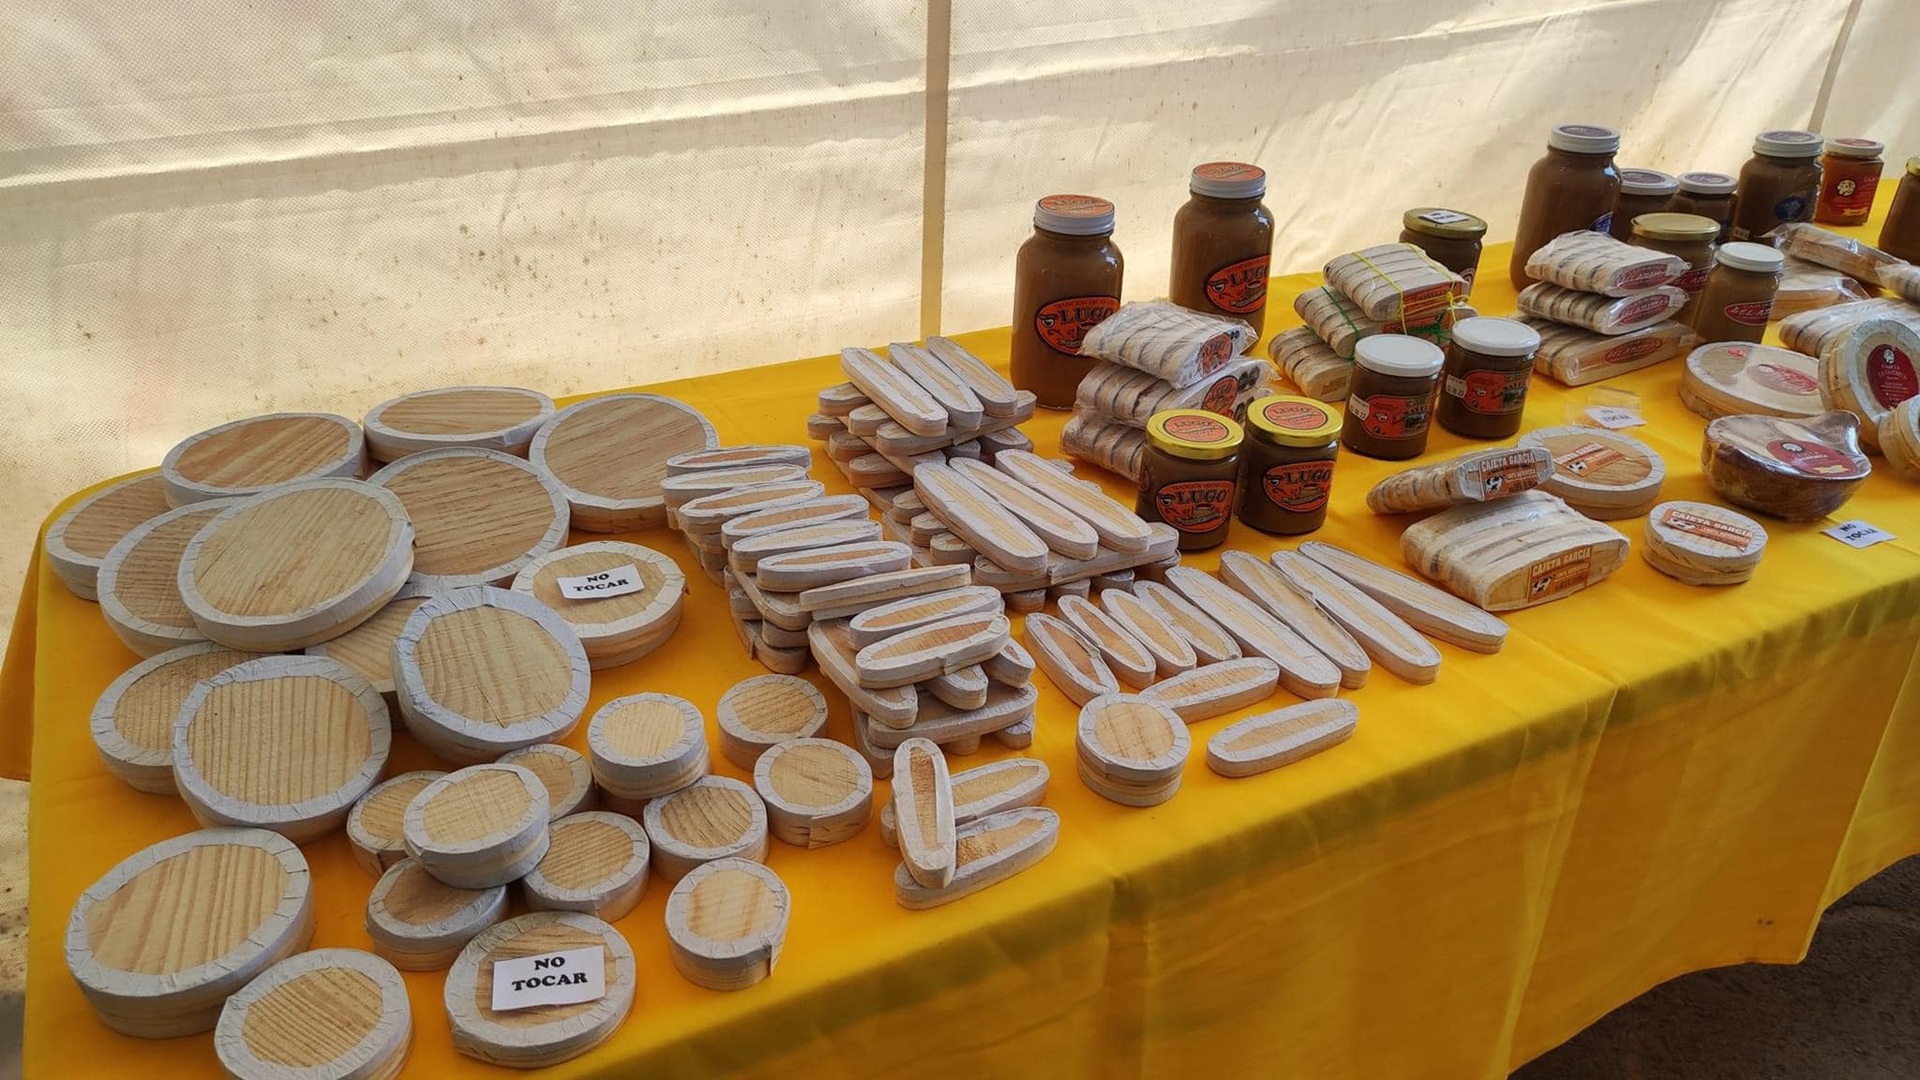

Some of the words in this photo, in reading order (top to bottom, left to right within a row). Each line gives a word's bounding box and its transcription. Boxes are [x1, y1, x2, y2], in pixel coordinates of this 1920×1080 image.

[1481, 456, 1508, 473] CAJETA
[1283, 468, 1332, 484] LUGO
[1173, 489, 1227, 505] LUGO
[1672, 510, 1711, 527] CAJETA
[1532, 557, 1561, 577] CAJETA
[573, 579, 629, 592] TOCAR
[586, 573, 610, 583] NO
[534, 956, 566, 971] NO
[511, 972, 589, 992] TOCAR
